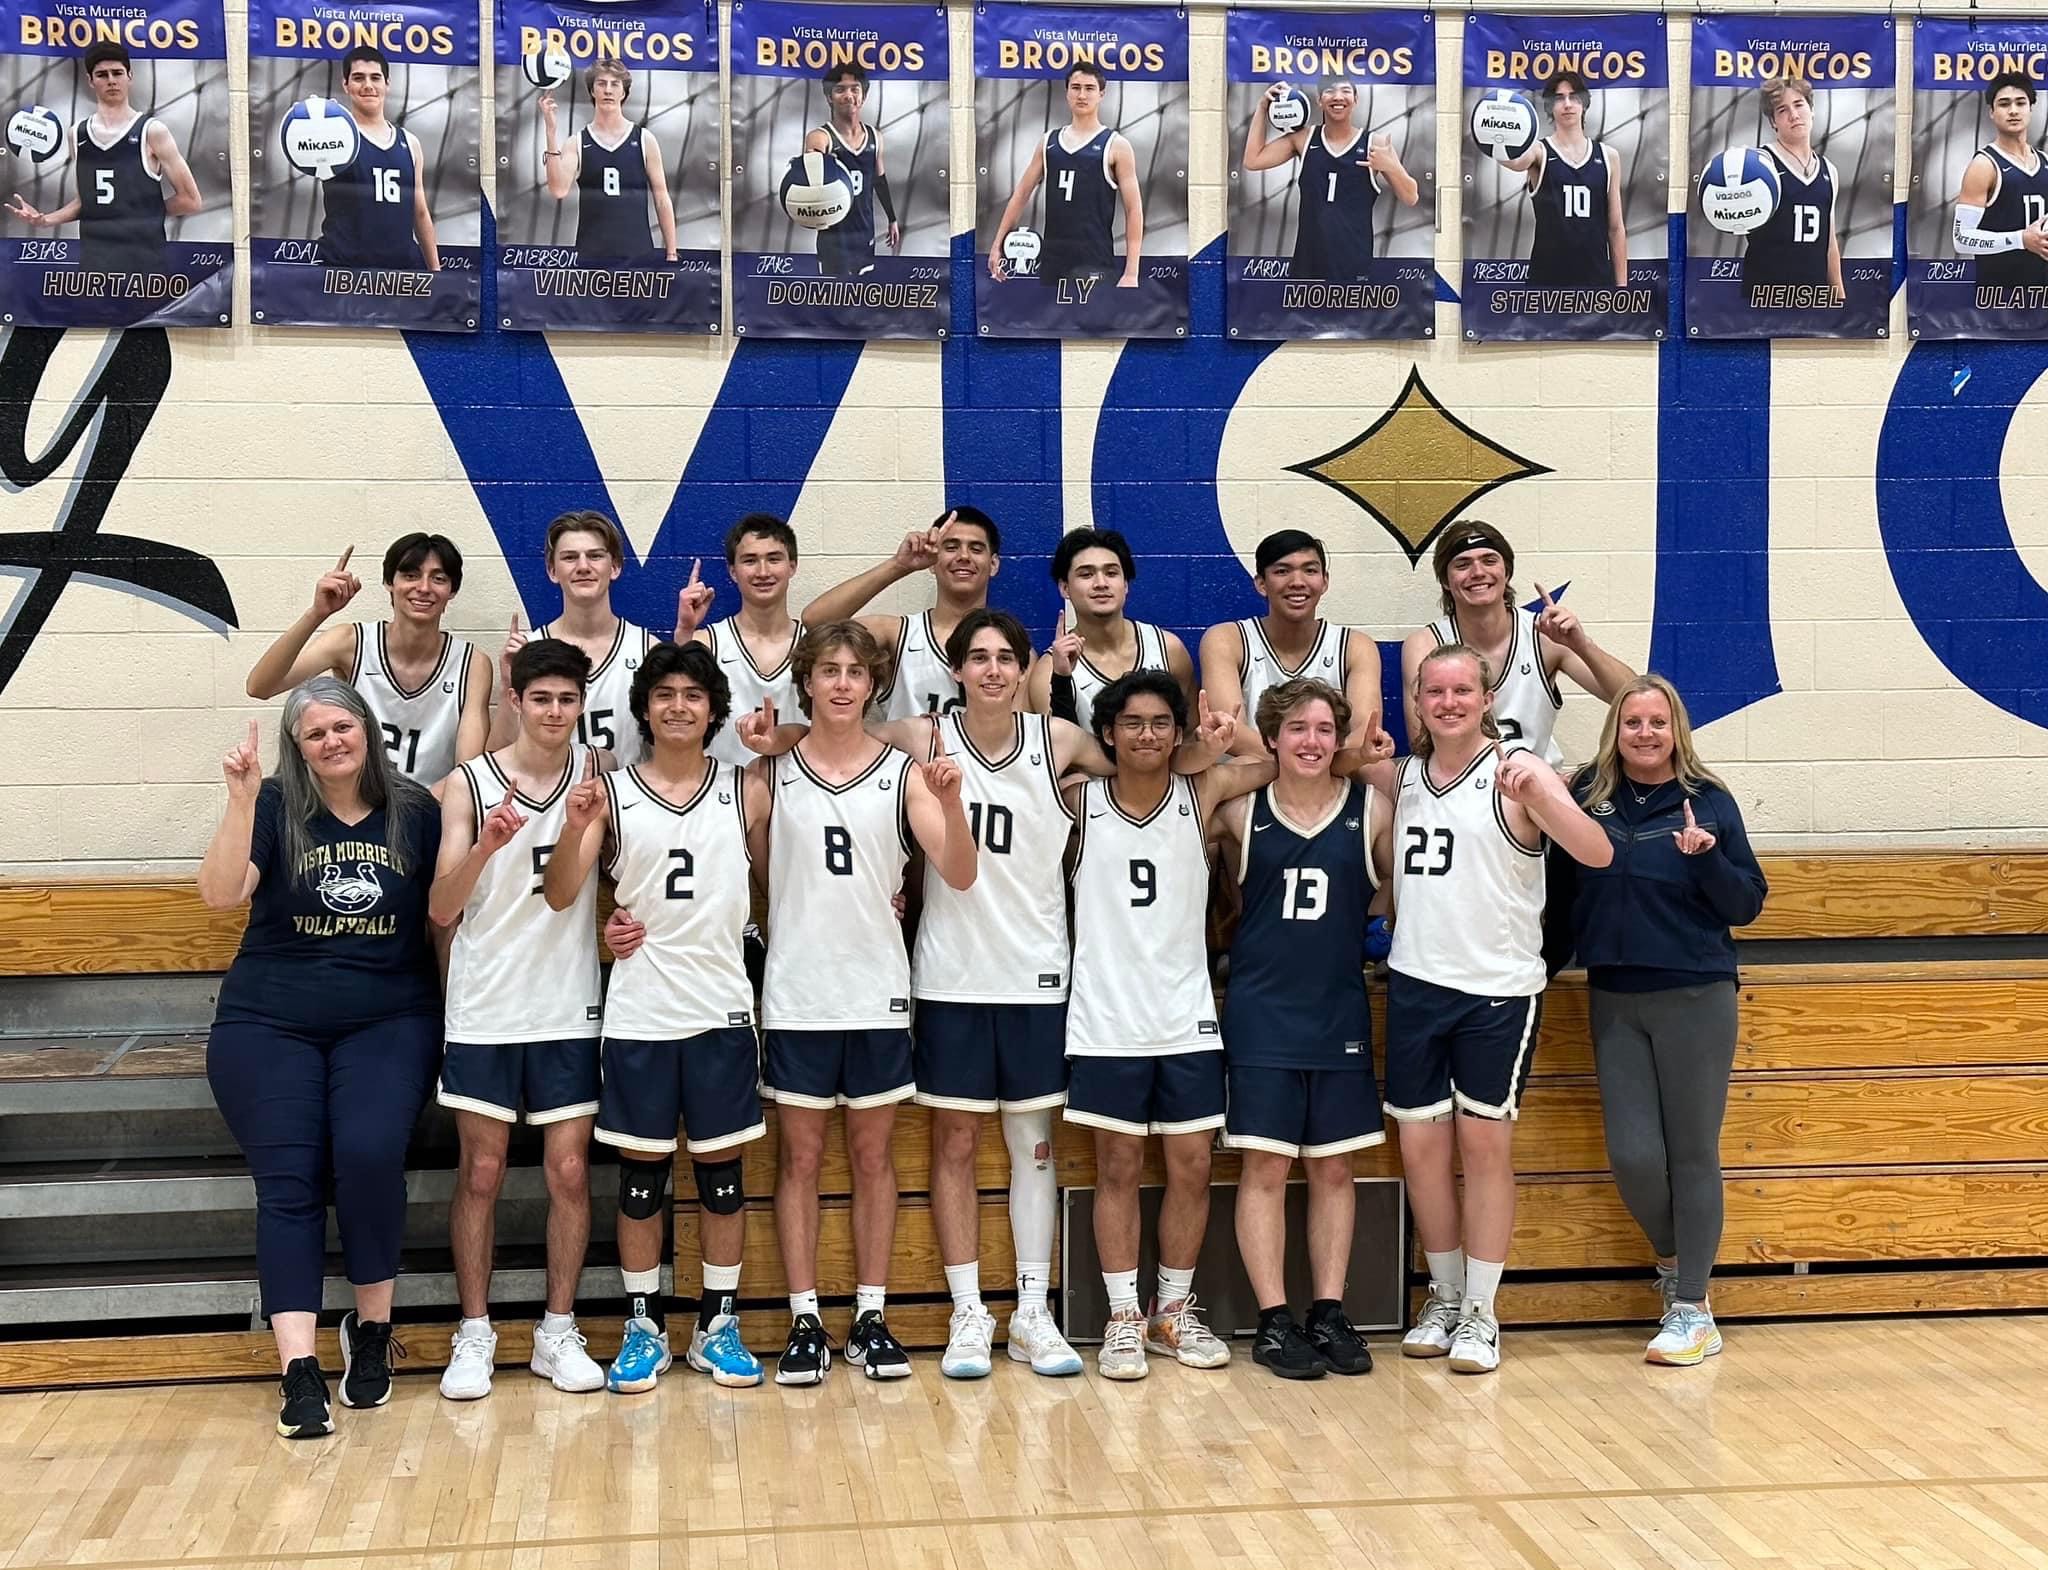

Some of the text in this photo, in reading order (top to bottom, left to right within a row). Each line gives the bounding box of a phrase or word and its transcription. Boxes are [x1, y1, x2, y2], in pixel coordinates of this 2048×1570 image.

[56, 4, 147, 18] Vista Murrieta
[313, 7, 404, 22] Vista Murrieta
[557, 16, 646, 31] Vista Murrieta
[20, 15, 200, 49] BRONCOS
[275, 17, 454, 56] BRONCOS
[520, 26, 695, 62] BRONCOS
[793, 27, 879, 41] Vista Murrieta
[1034, 29, 1119, 42] Vista Murrieta
[1285, 35, 1368, 48] Vista Murrieta
[1522, 39, 1603, 51] Vista Murrieta
[756, 37, 925, 72] BRONCOS
[999, 40, 1165, 73] BRONCOS
[1747, 39, 1831, 52] Vista Murrieta
[1967, 41, 2048, 52] Vista Murrieta
[1251, 45, 1414, 76] BRONCOS
[1486, 50, 1646, 80] BRONCOS
[1715, 49, 1873, 80] BRONCOS
[1933, 53, 2048, 81] BRONC
[95, 169, 115, 204] 5
[372, 167, 401, 203] 16
[603, 167, 621, 196] 8
[1057, 170, 1075, 201] 4
[1326, 172, 1338, 202] 1
[1562, 184, 1591, 218] 10
[1793, 204, 1820, 243] 13
[19, 241, 69, 260] ISIAS
[189, 253, 225, 266] 2024
[274, 241, 324, 264] ADAL
[440, 256, 473, 270] 2024
[502, 248, 579, 268] EMERSON
[679, 260, 712, 273] 2024
[756, 255, 794, 275] JAKE
[909, 267, 941, 280] 2024
[1148, 266, 1179, 279] 2024
[1243, 259, 1290, 279] AARON
[1395, 268, 1427, 280] 2024
[1472, 262, 1531, 281] PRESTON
[1629, 270, 1661, 282] 2024
[1710, 259, 1740, 278] BEN
[1851, 269, 1884, 281] 2024
[1927, 262, 1966, 280] JOSH
[43, 271, 190, 299] HURTADO
[323, 269, 435, 297] IBANEZ
[533, 269, 675, 299] VINCENT
[767, 281, 939, 308] DOMINGUEZ
[1056, 278, 1097, 304] LY
[1282, 284, 1400, 309] MORENO
[1490, 289, 1651, 314] STEVENSON
[1750, 284, 1845, 309] HEISEL
[578, 708, 615, 751] 15
[381, 722, 422, 773] 21
[968, 801, 1014, 855] 10
[824, 826, 853, 876] 8
[1404, 826, 1455, 876] 23
[665, 849, 694, 899] 2
[1129, 859, 1157, 907] 9
[1281, 867, 1330, 921] 13
